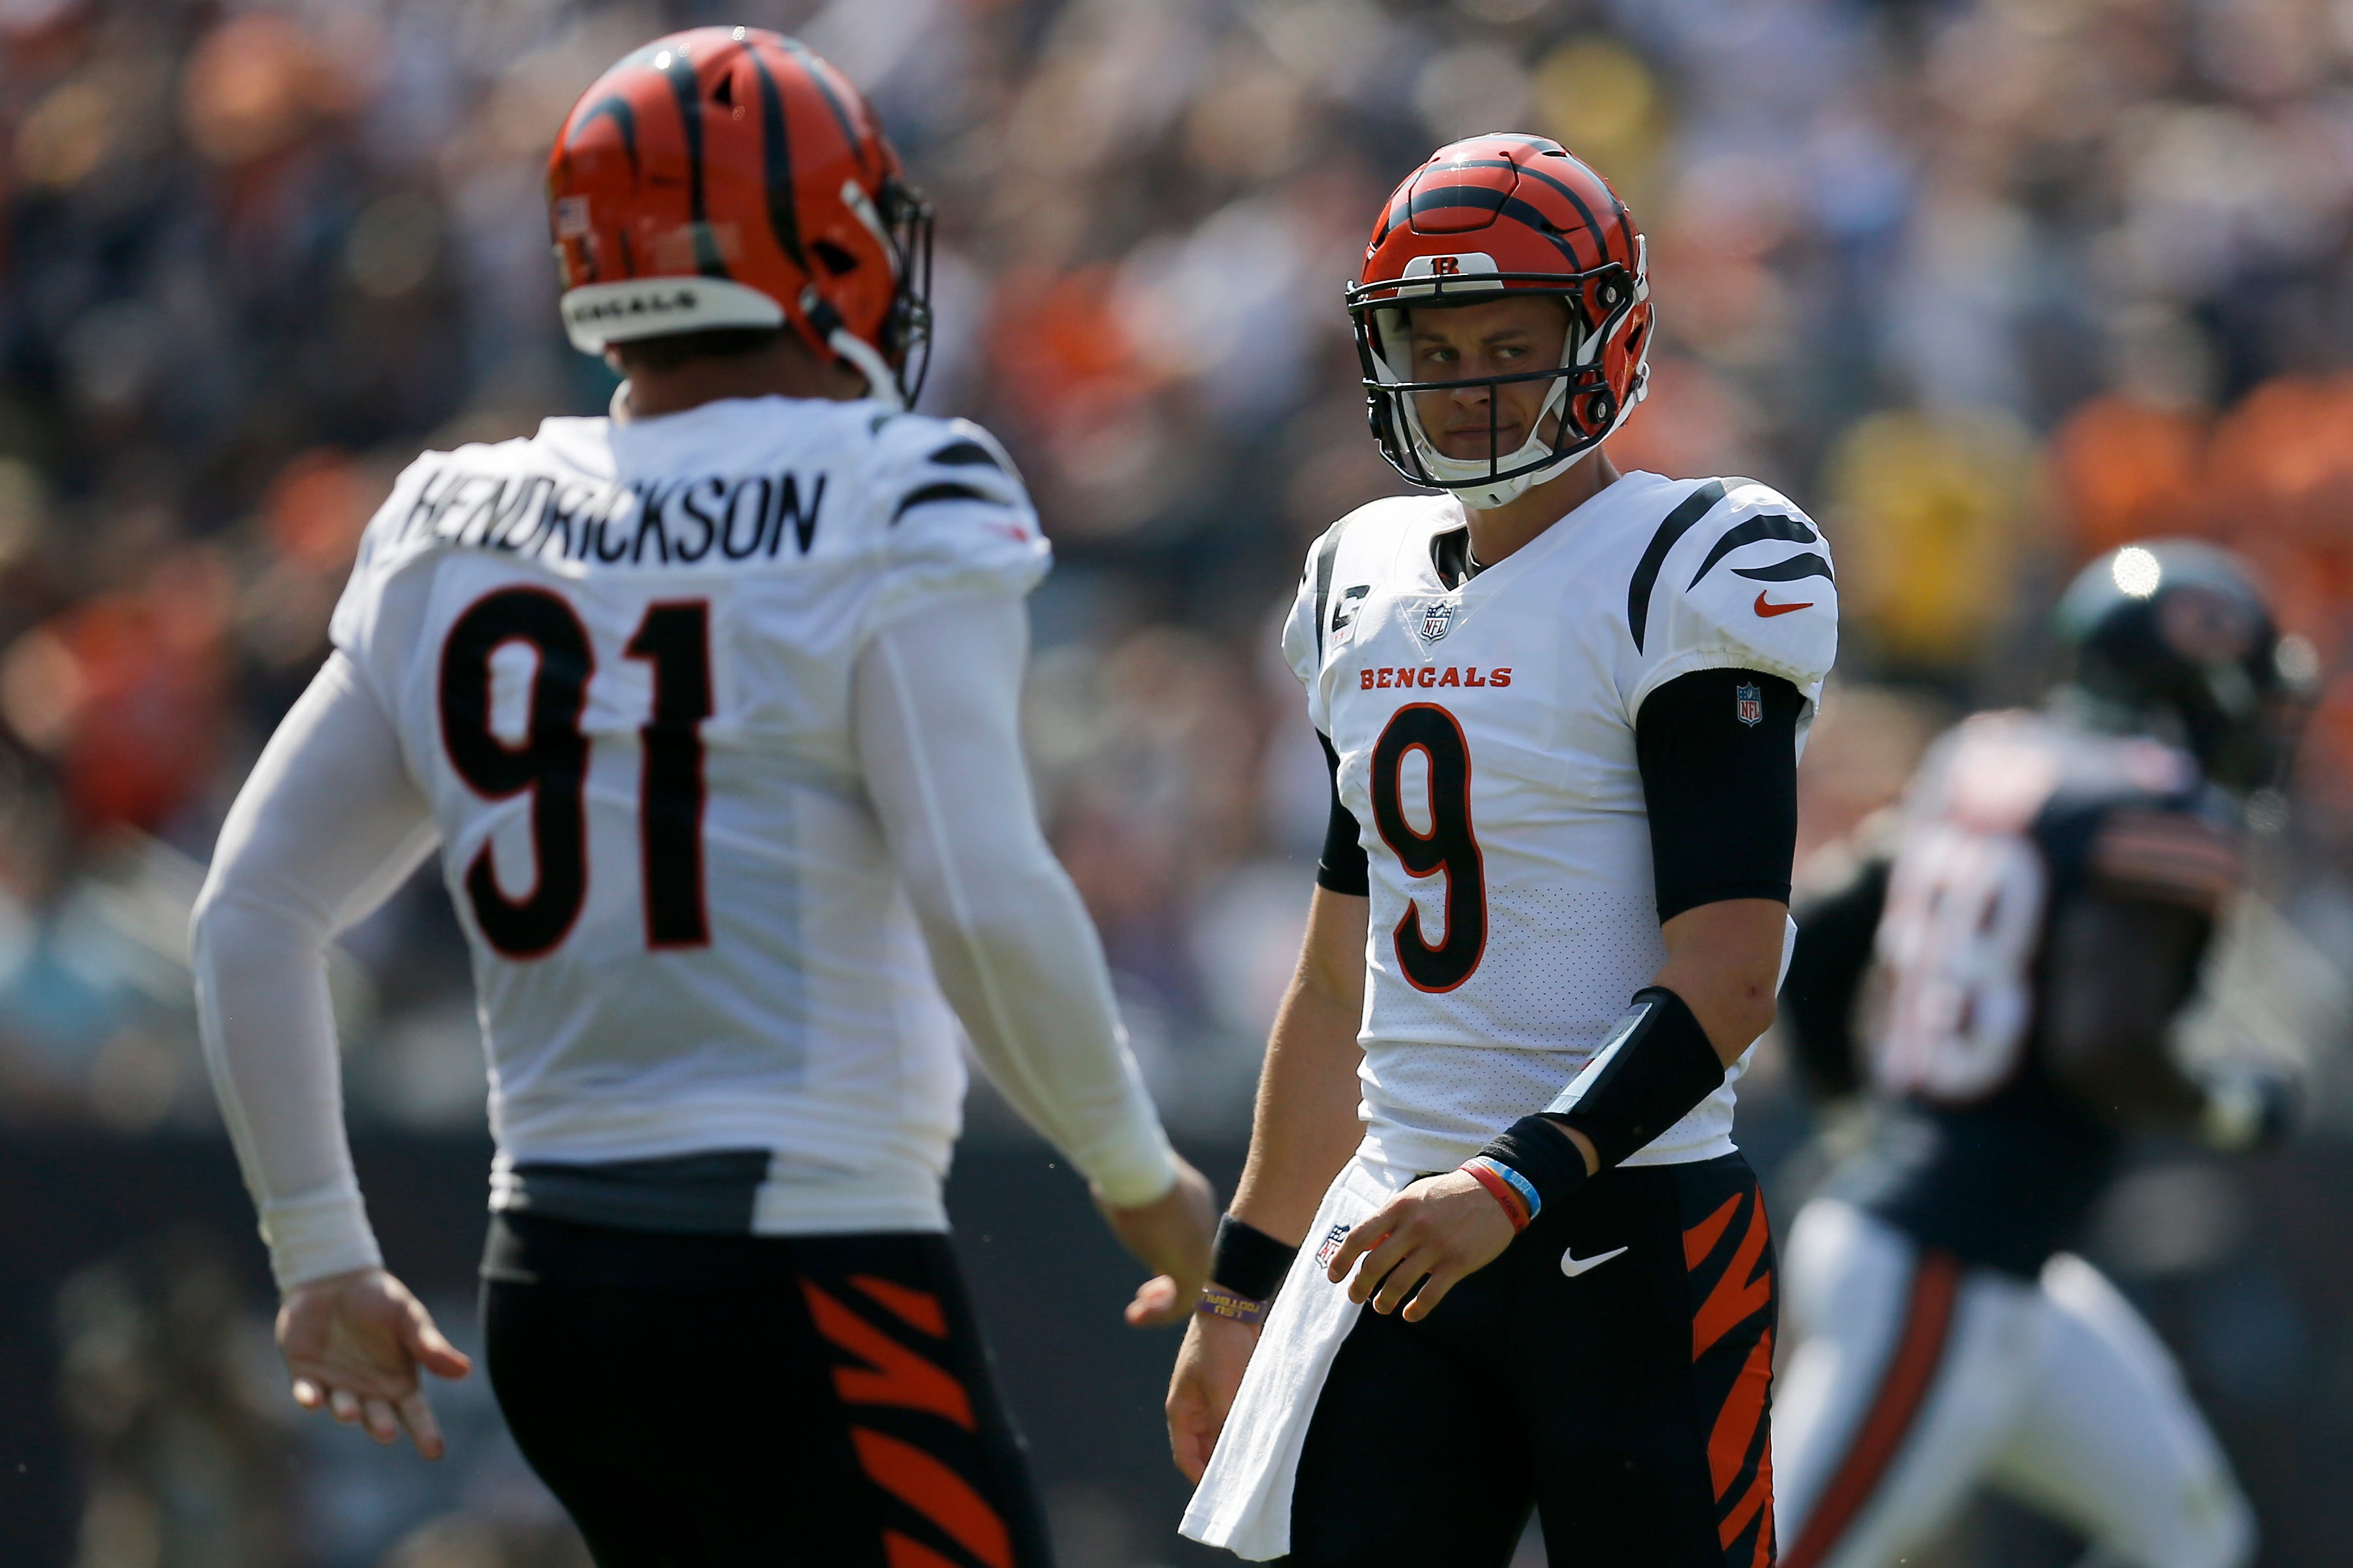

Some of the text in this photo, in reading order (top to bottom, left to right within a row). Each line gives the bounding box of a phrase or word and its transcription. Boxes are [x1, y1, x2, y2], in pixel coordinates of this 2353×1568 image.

[1431, 257, 1460, 275] B
[398, 469, 827, 564] HENDRICKSON
[1423, 619, 1445, 635] NFL
[1360, 667, 1512, 690] BENGALS
[1741, 701, 1760, 720] NFL
[437, 582, 714, 961] 91
[1370, 702, 1487, 994] 9
[1317, 1239, 1340, 1264] NF
